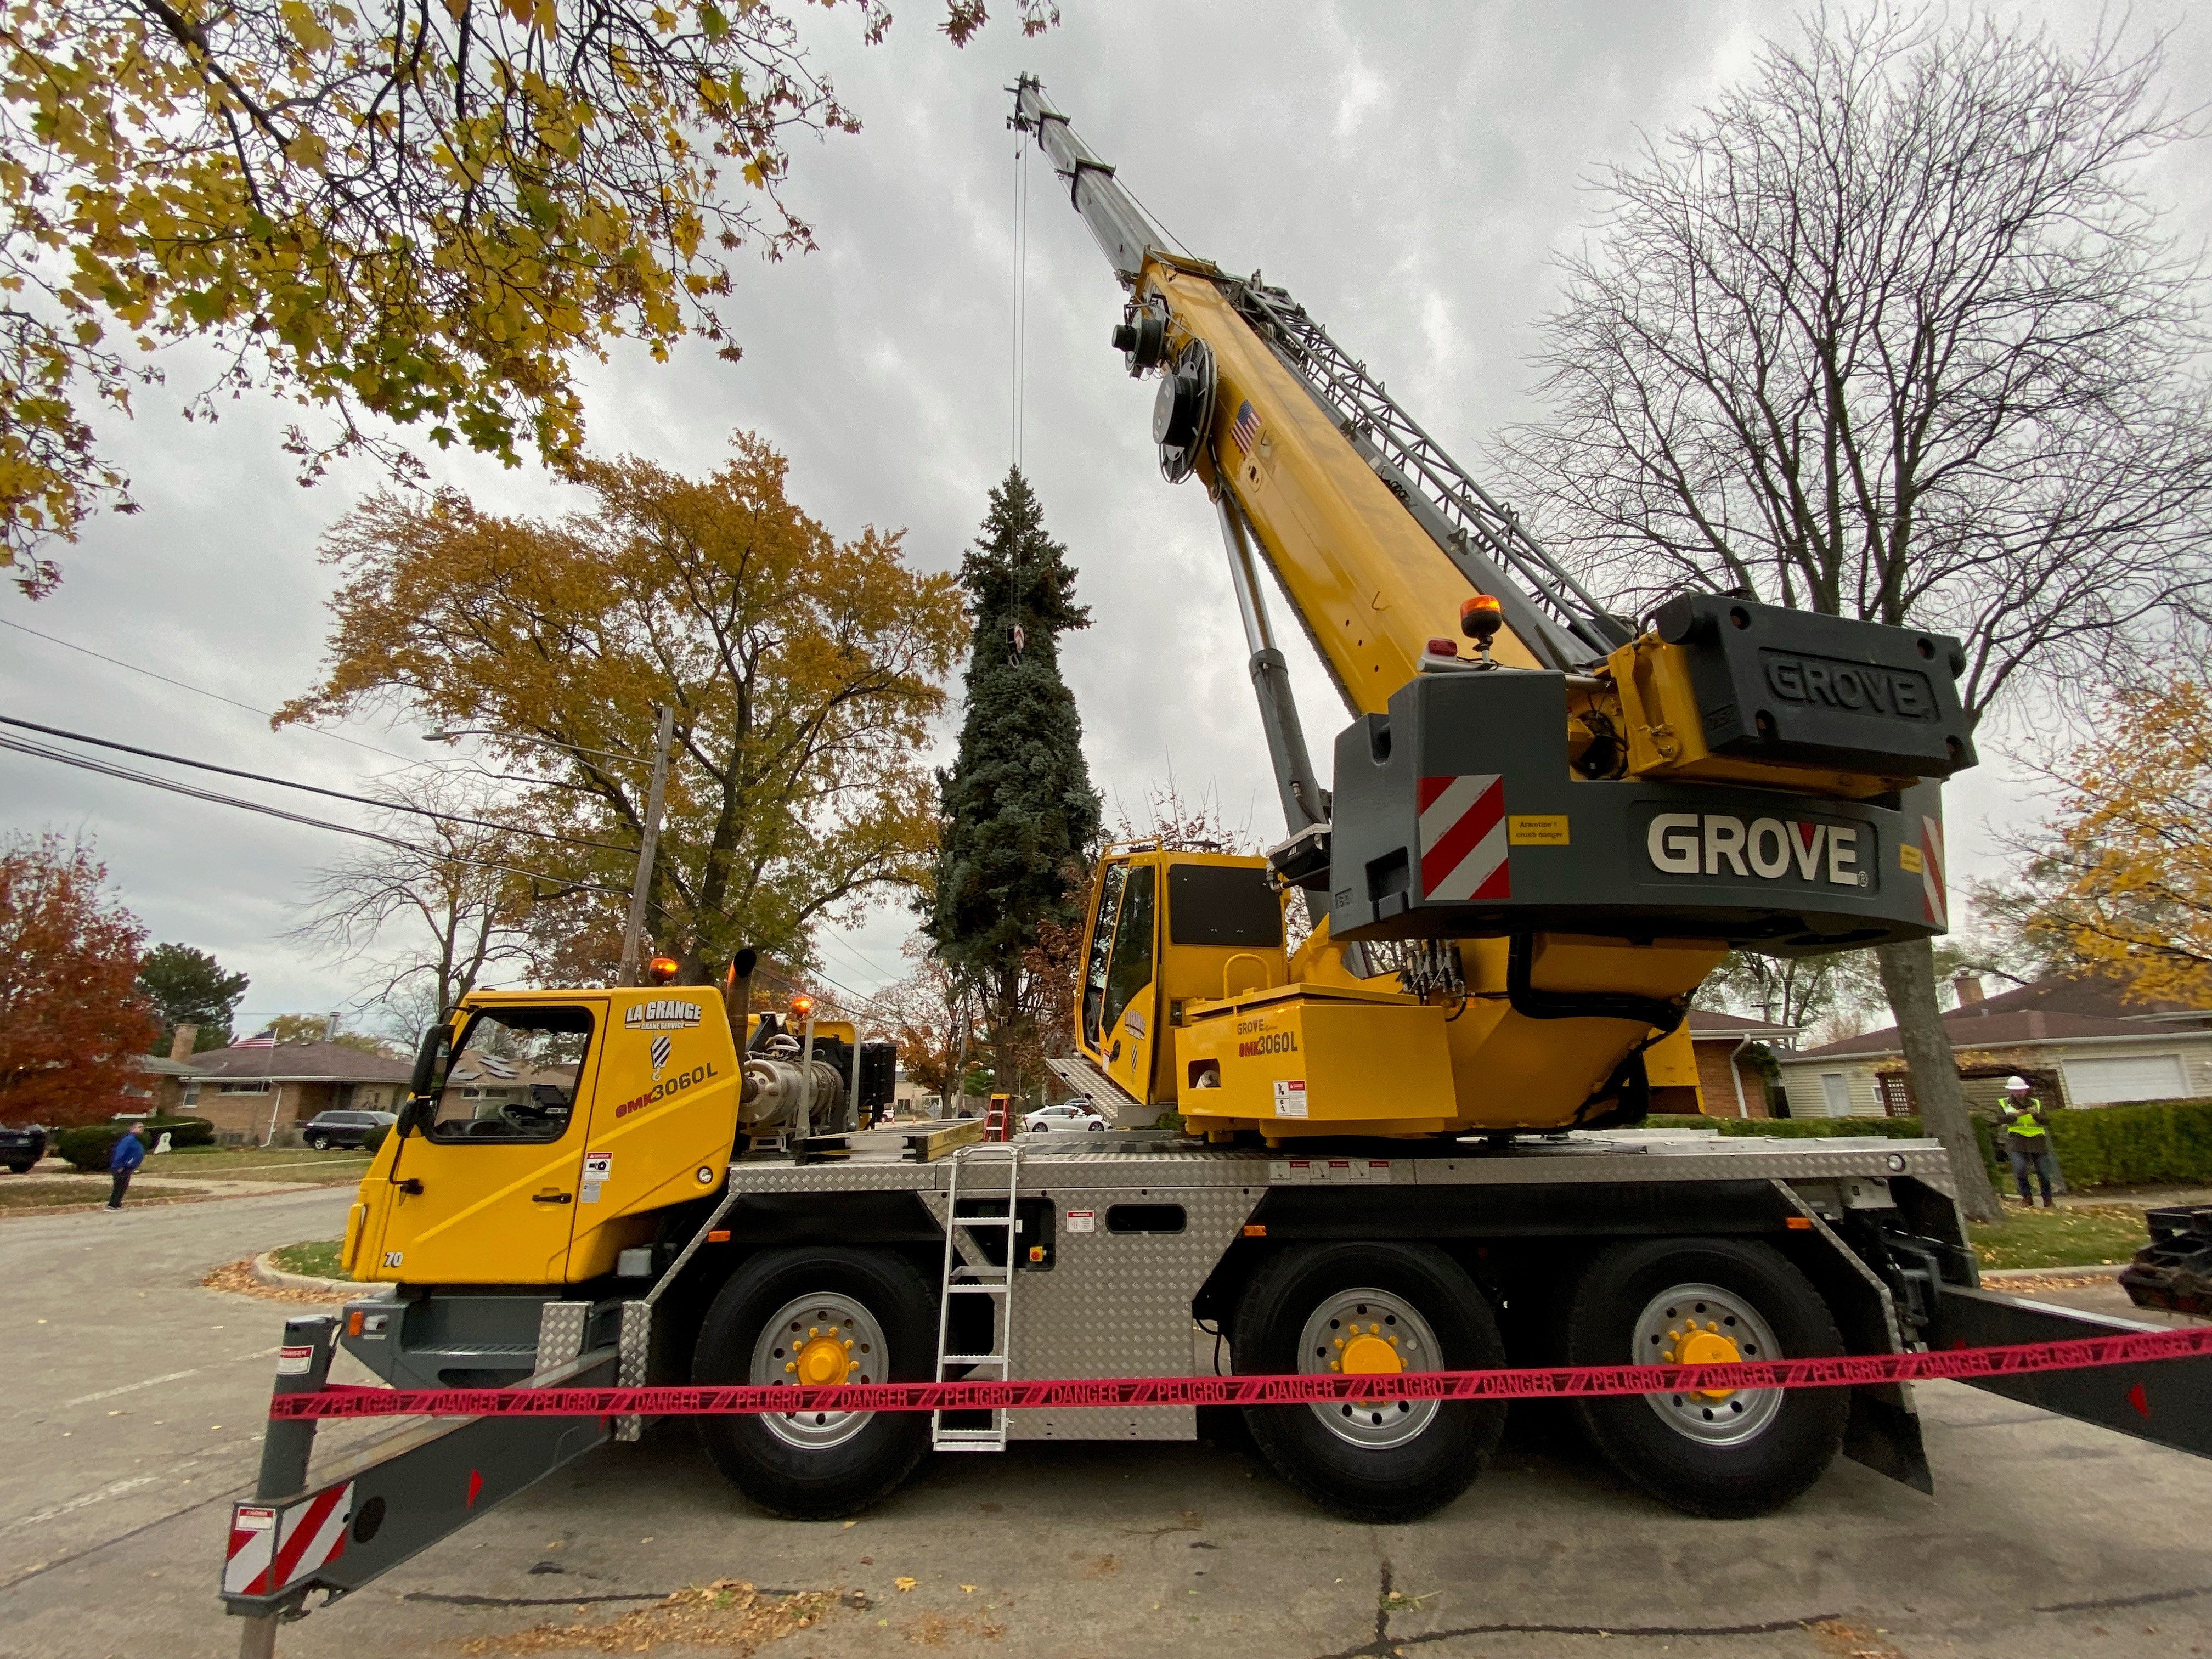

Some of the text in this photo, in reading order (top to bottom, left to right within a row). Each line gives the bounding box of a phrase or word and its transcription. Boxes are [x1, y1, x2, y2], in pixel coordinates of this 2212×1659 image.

[1762, 657, 1925, 719] GROVE
[1647, 813, 1859, 885] GROVE
[625, 1000, 702, 1024] LA GRANGE
[1237, 1018, 1264, 1035] GROVE
[382, 1251, 403, 1268] 70
[438, 1393, 498, 1412] DANGER
[534, 1393, 599, 1412] PELIGRO
[634, 1392, 700, 1410] DANGER
[736, 1391, 803, 1408] PELIGRO
[840, 1389, 908, 1408] DANGER
[945, 1387, 1013, 1406] PELIGRO
[1051, 1385, 1120, 1403] DANGER
[1157, 1383, 1227, 1401] PELIGRO
[1265, 1380, 1335, 1399] DANGER
[1373, 1378, 1444, 1397] PELIGRO
[1483, 1374, 1555, 1393] DANGER
[1593, 1371, 1666, 1391] PELIGRO
[1703, 1367, 1776, 1387] DANGER
[1813, 1360, 1885, 1381] PELIGRO
